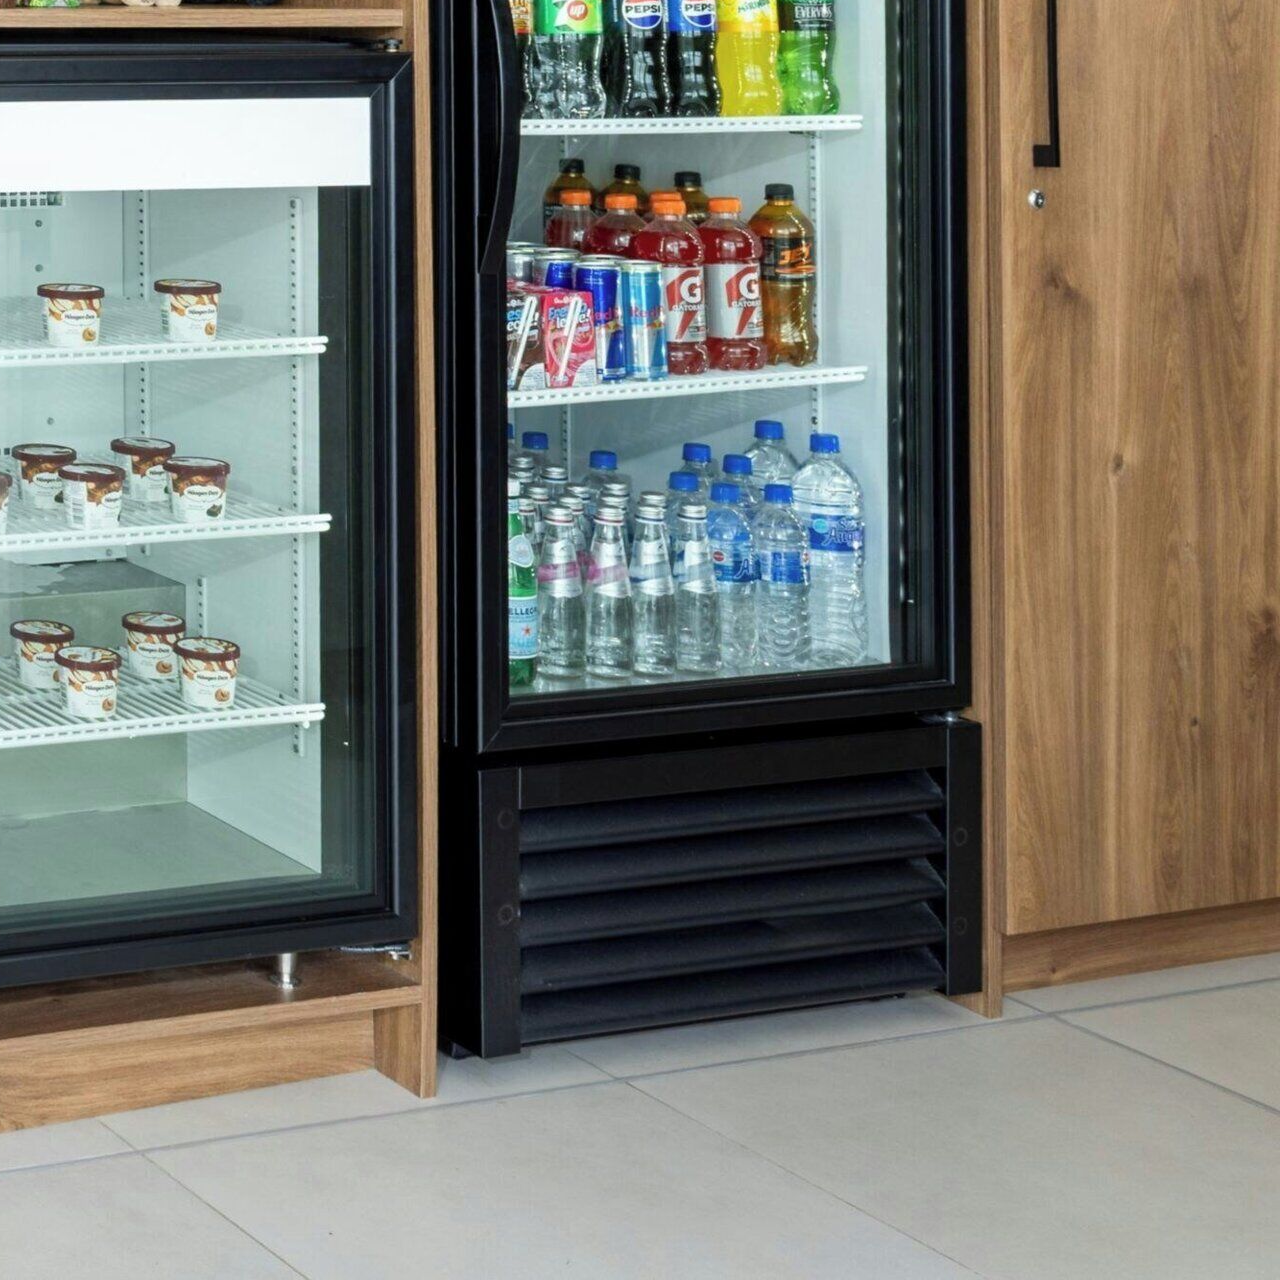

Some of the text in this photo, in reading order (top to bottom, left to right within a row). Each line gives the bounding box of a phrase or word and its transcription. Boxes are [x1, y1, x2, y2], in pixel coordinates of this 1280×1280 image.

[625, 4, 661, 13] PEPSI
[681, 275, 701, 303] G
[739, 272, 759, 299] G
